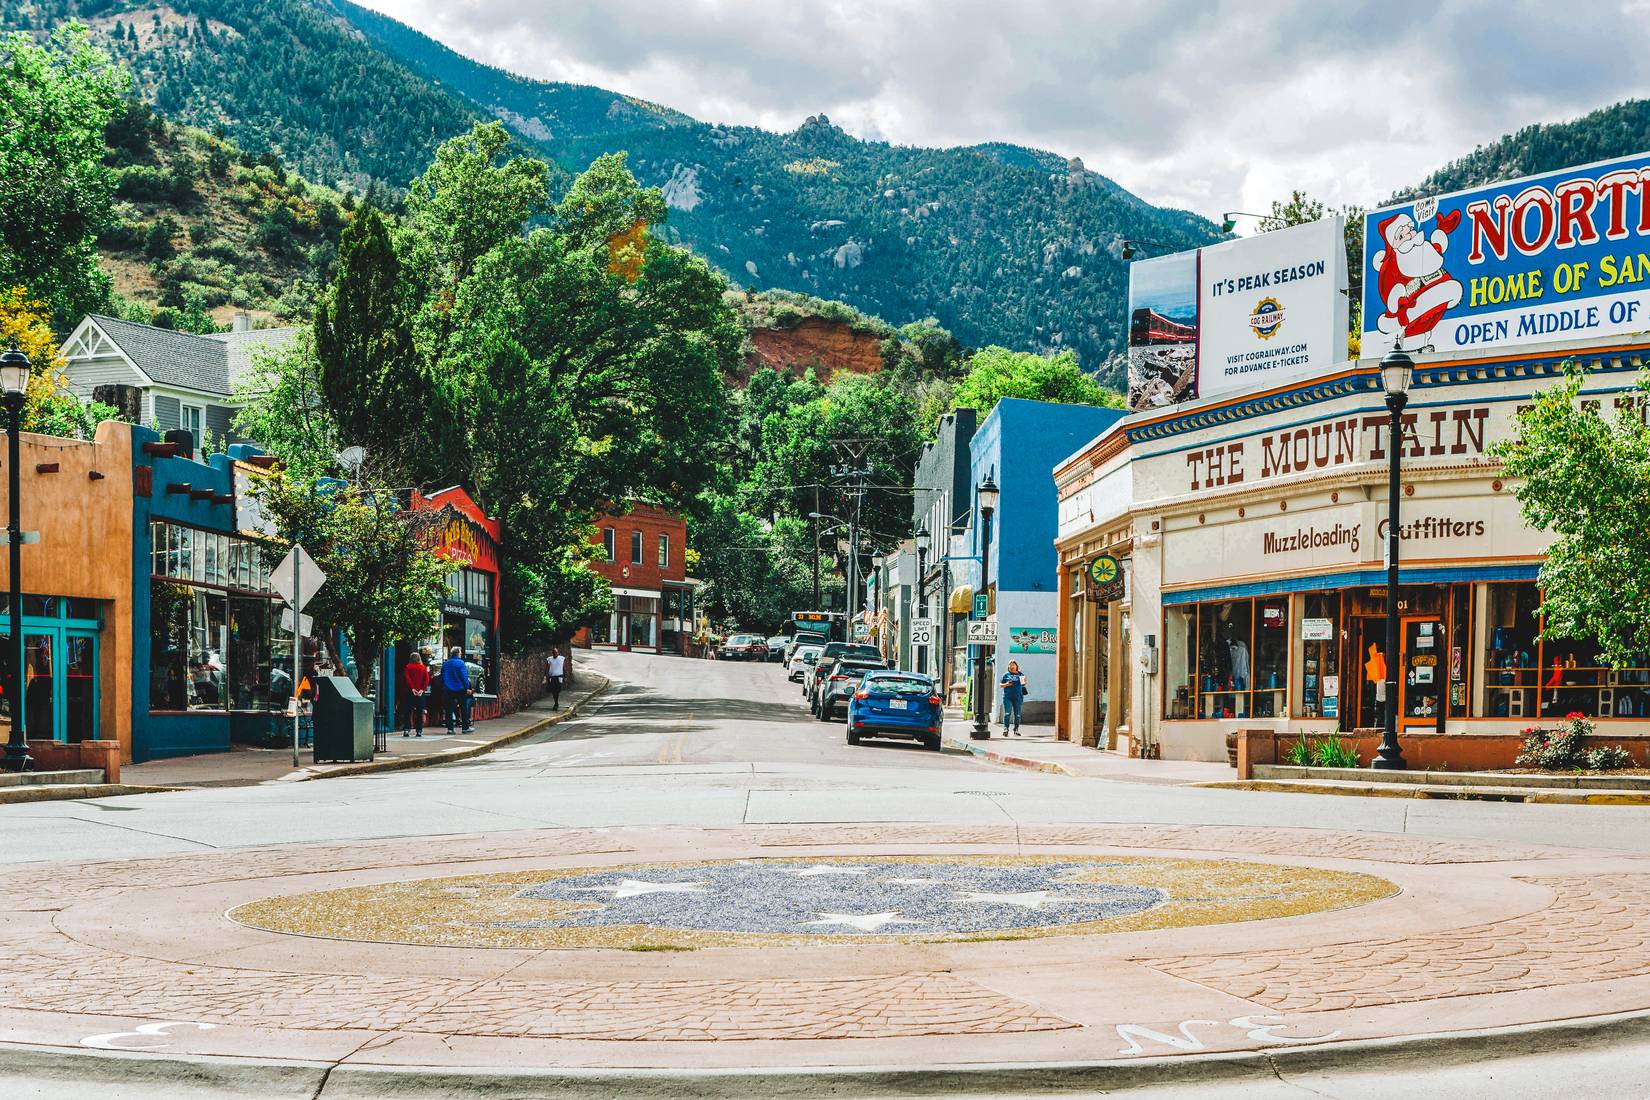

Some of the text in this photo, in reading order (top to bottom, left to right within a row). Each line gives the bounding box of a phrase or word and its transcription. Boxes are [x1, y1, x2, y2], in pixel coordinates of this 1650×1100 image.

[1417, 205, 1435, 220] Visit
[1212, 260, 1325, 297] IT'S PEAK SEASON
[1469, 271, 1545, 308] HOME
[1553, 261, 1590, 294] OF
[1250, 312, 1284, 325] COG RAILWAY
[1454, 300, 1641, 346] OPEN MIDDLE OF
[1227, 343, 1308, 364] VISIT COGRAILWAY.COM
[1224, 355, 1310, 376] FOR ADVANCE E-TICKETS
[1186, 442, 1244, 491] THE
[1261, 408, 1490, 478] MOUNTAIN
[1263, 523, 1361, 554] Muzzleloading
[451, 547, 473, 565] PIZZA
[912, 632, 930, 642] 20
[1041, 630, 1057, 643] BR
